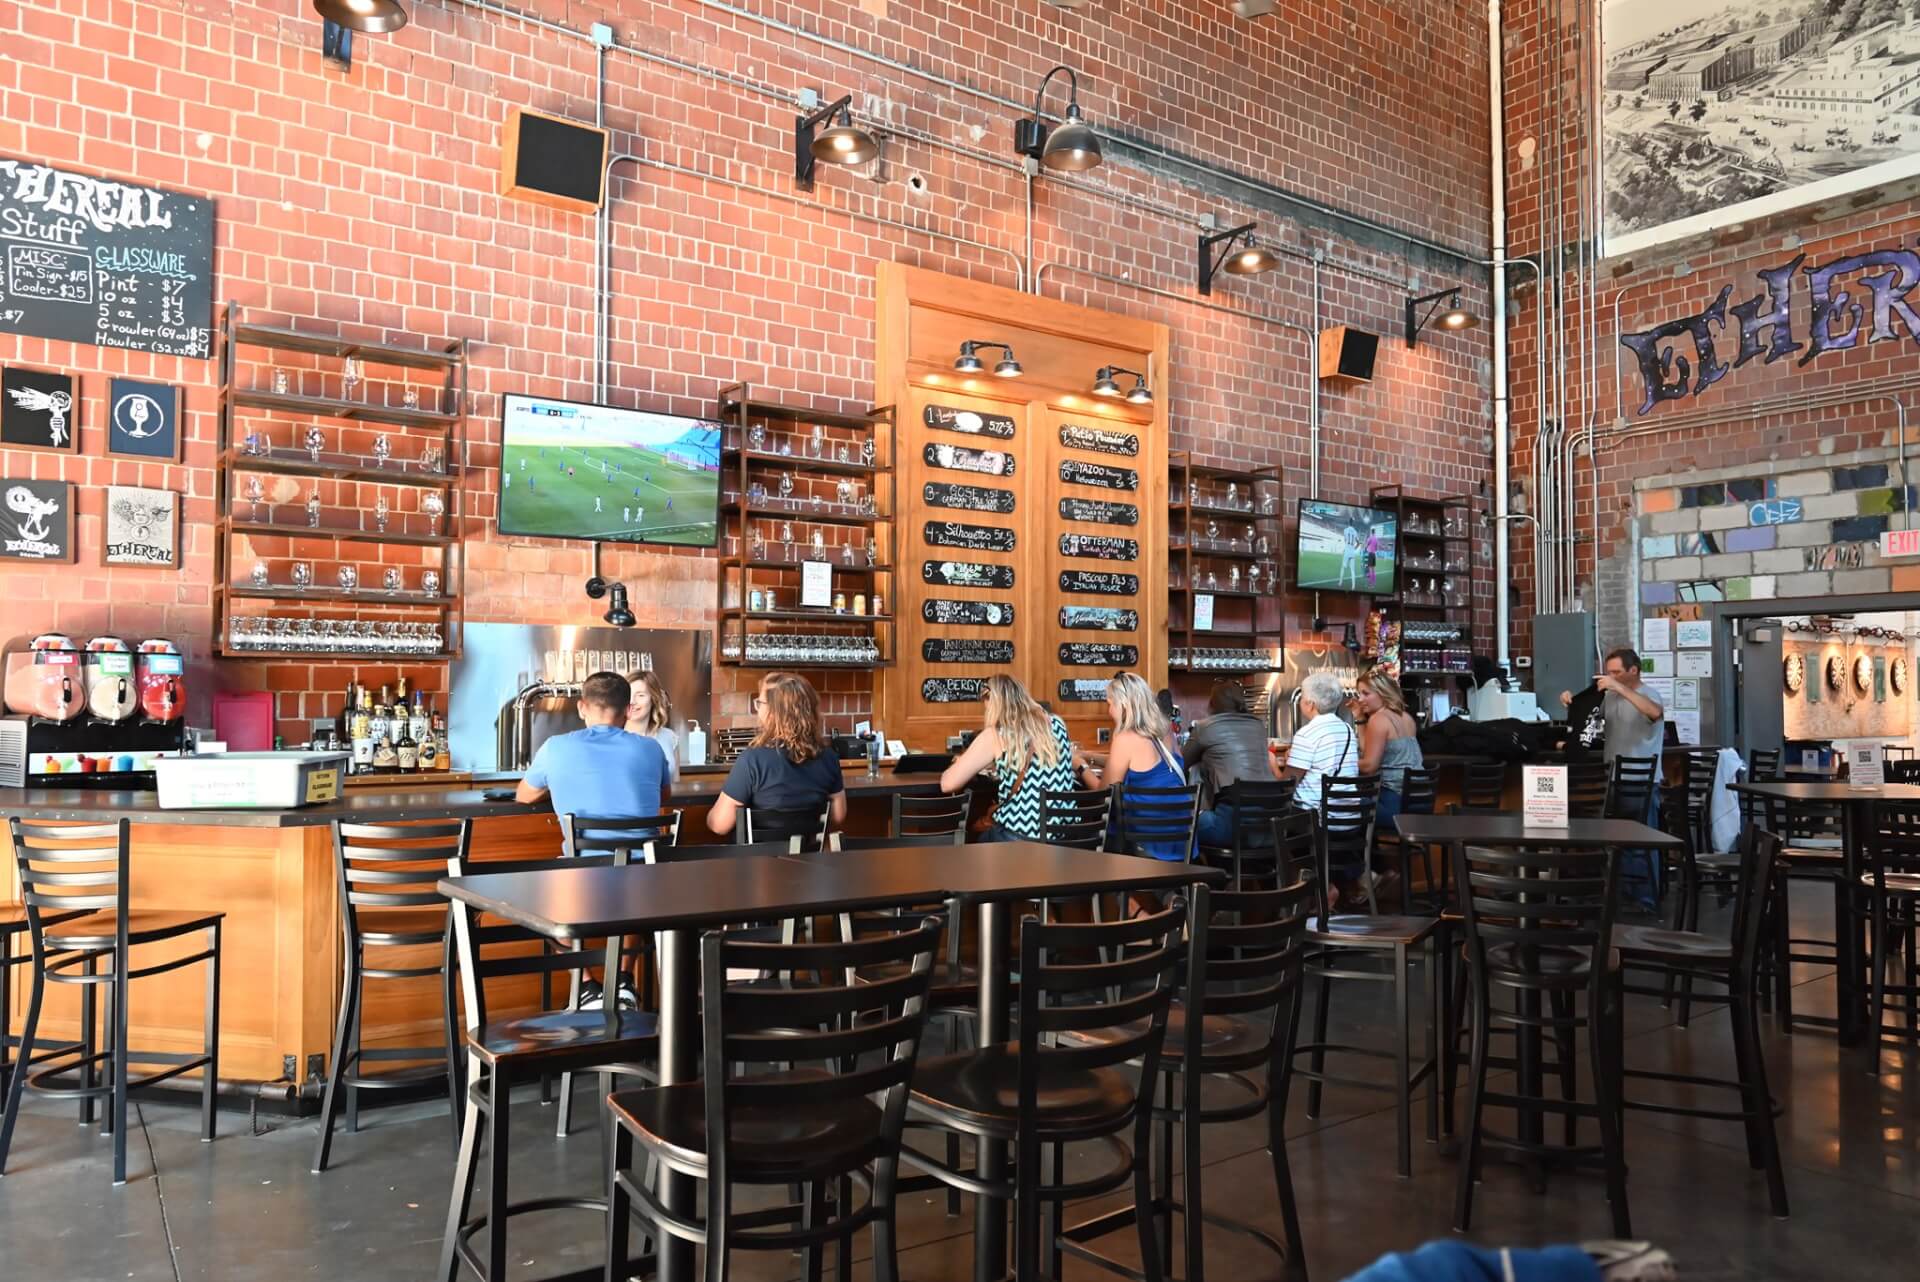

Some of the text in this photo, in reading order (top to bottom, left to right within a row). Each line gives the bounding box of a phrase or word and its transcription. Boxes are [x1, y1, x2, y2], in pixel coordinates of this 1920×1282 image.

[2, 207, 87, 245] Stuff
[14, 250, 68, 268] MISC:
[95, 246, 187, 274] GLASSWARE
[14, 266, 34, 278] Tin
[37, 268, 62, 284] Sign
[96, 271, 139, 291] Pint
[162, 279, 187, 296] $7
[99, 290, 117, 302] 10
[121, 296, 137, 305] oz
[161, 296, 184, 311] $4
[98, 303, 110, 317] 5
[118, 310, 135, 319] oz
[161, 310, 185, 326] $3
[97, 318, 155, 337] Growler
[95, 332, 146, 349] Howler
[1080, 463, 1105, 475] YAZOO
[968, 540, 985, 549] Dark
[1080, 535, 1125, 549] OTTERMAN
[1887, 529, 1919, 553] EXIT
[106, 541, 173, 561] ETHEREAL
[924, 563, 933, 578] 5
[924, 601, 934, 617] 6
